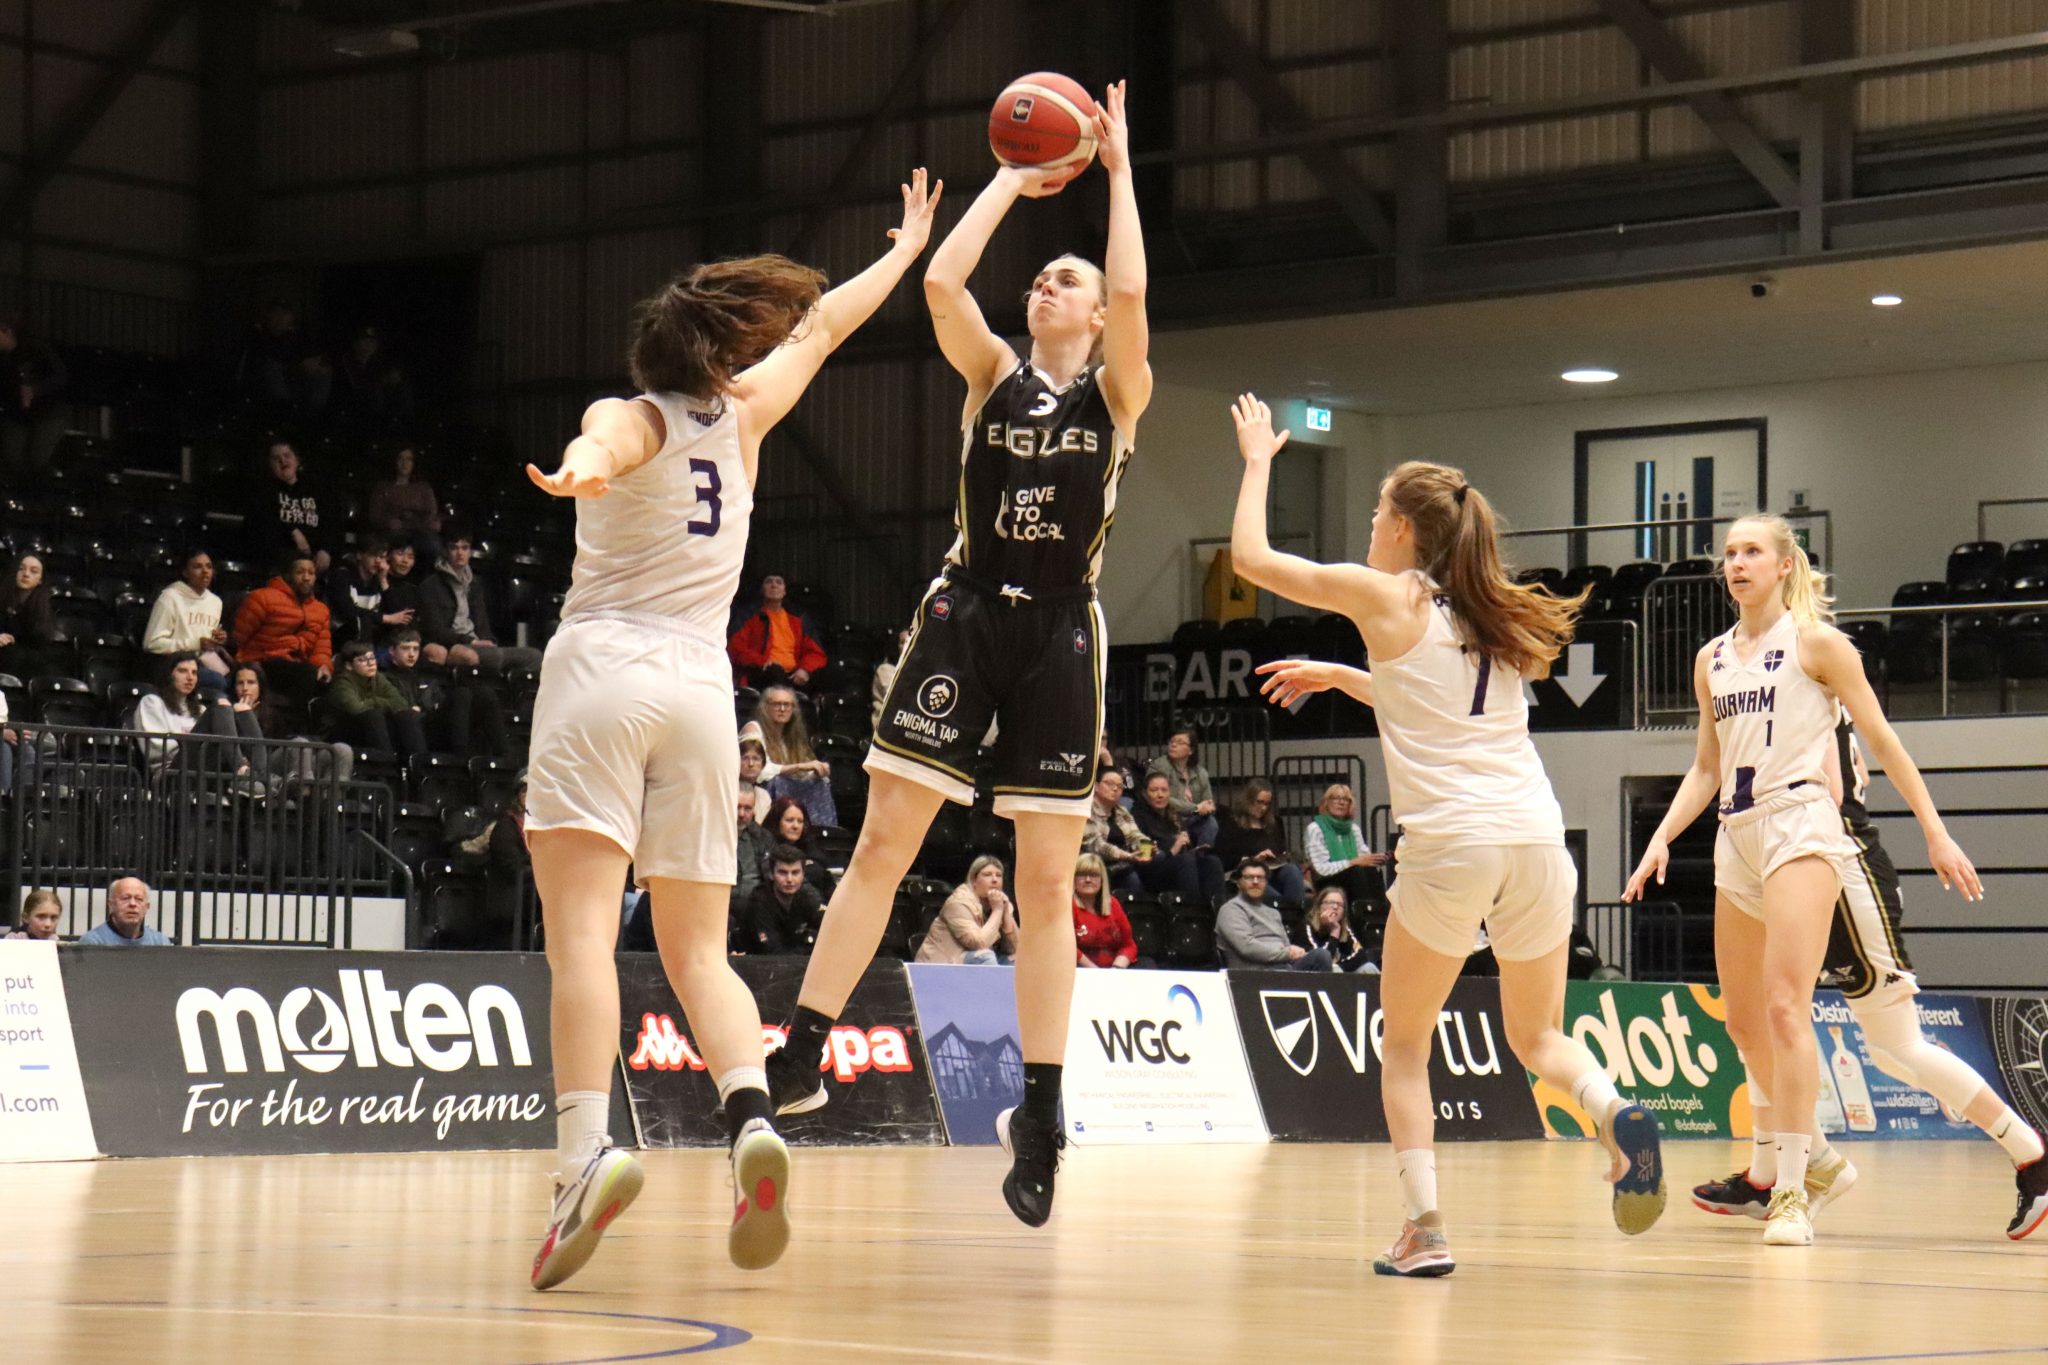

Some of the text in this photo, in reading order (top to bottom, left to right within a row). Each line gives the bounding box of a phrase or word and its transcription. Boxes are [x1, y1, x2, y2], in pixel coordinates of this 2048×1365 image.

[1028, 391, 1058, 416] 3
[986, 421, 1098, 460] EGLES
[687, 457, 722, 537] 3
[1015, 486, 1056, 505] GIVE
[1013, 505, 1041, 522] TO
[1012, 523, 1065, 541] LOCAL
[1143, 648, 1252, 701] BAR
[893, 709, 959, 743] ENIGMA TAP
[1765, 720, 1773, 747] 1
[1040, 763, 1083, 774] EAGLES
[5, 975, 35, 993] put
[4, 1000, 39, 1015] into
[1811, 1000, 1857, 1024] Distin
[175, 969, 532, 1073] molten
[1317, 990, 1502, 1076] Vtu
[0, 1027, 44, 1045] sport
[1091, 1019, 1191, 1065] WGC
[1572, 988, 1718, 1088] dot.
[181, 1077, 546, 1140] For the real game
[1666, 1093, 1704, 1115] bagels
